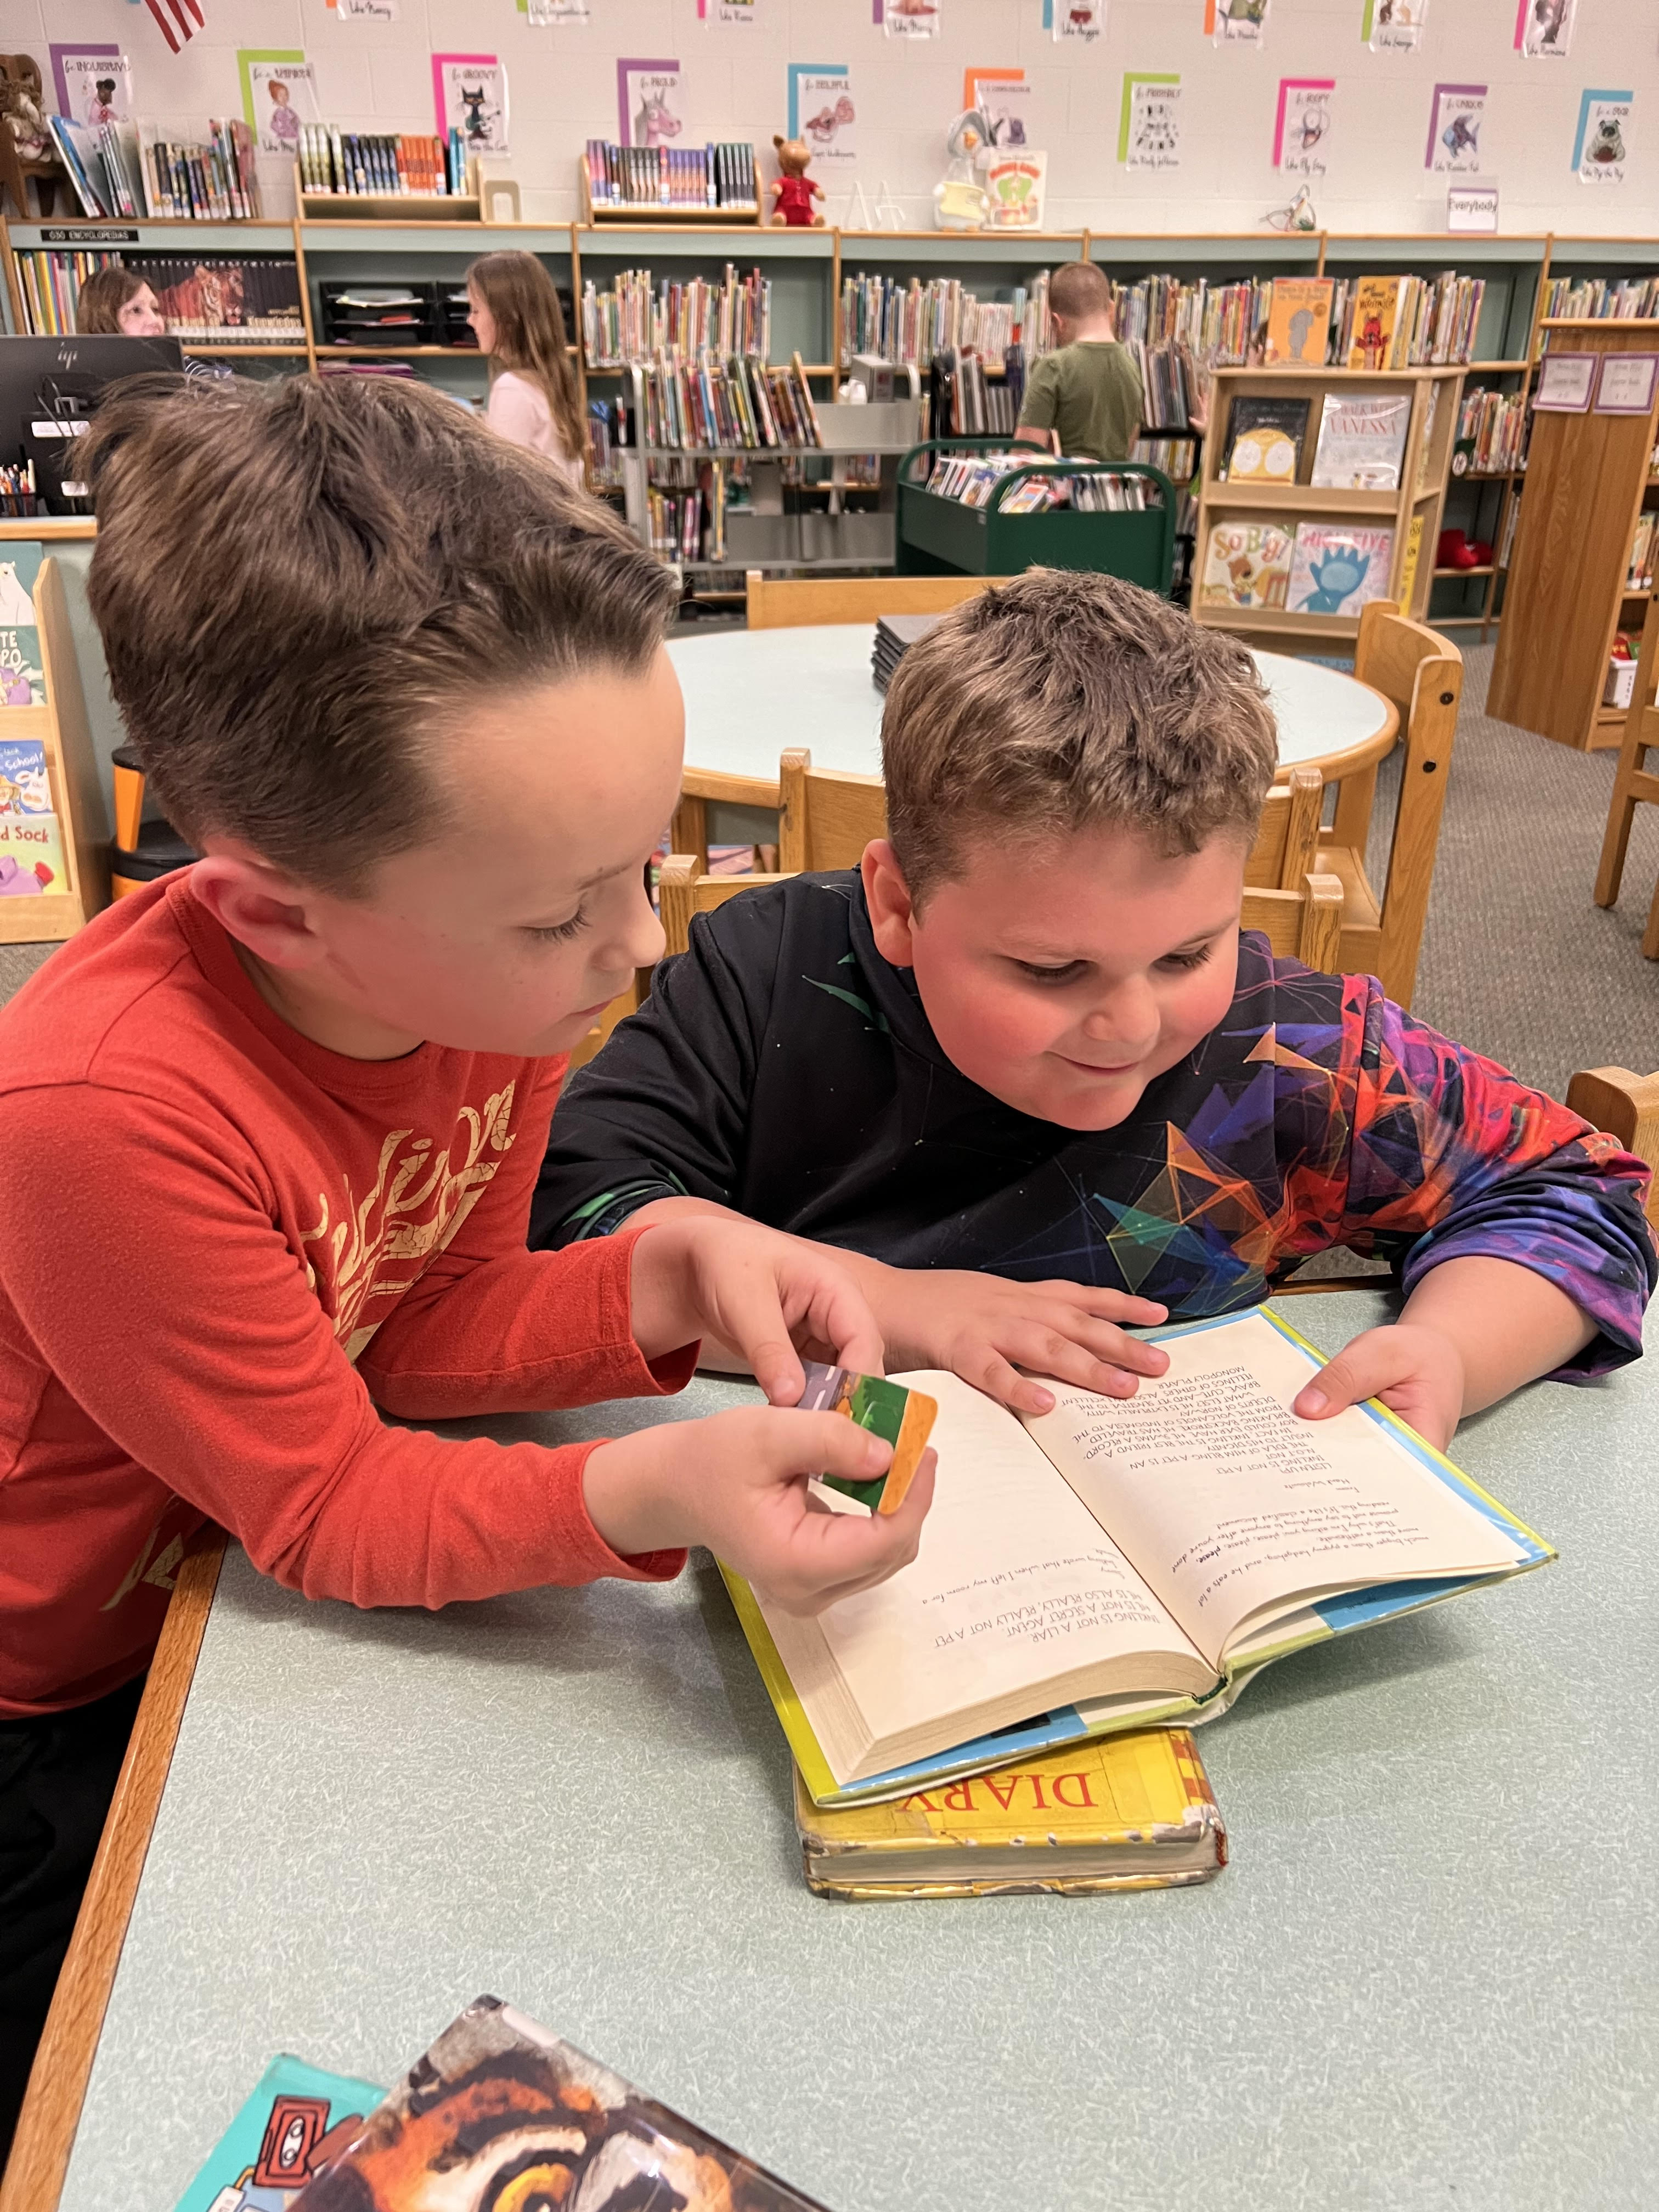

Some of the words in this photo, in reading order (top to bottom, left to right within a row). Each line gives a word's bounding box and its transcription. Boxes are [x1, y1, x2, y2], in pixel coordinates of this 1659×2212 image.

[1448, 198, 1498, 215] Everybody
[15, 825, 48, 843] Sock
[1194, 1367, 1244, 1381] MONOPOLY
[1211, 1373, 1253, 1387] FEELINGS
[1134, 1392, 1156, 1400] ALSO
[1223, 1392, 1255, 1402] WHAT
[1196, 1398, 1221, 1407] ELSE?
[1237, 1396, 1276, 1408] DESERTS
[1118, 1407, 1166, 1415] EXTREMELY
[1255, 1404, 1282, 1414] FROM
[1176, 1412, 1235, 1424] VOLCANOES
[1240, 1412, 1290, 1424] BREAKING
[1108, 1420, 1159, 1430] INDONESIA
[1244, 1422, 1276, 1431] COULD
[1071, 1429, 1090, 1444] THE
[1090, 1429, 1136, 1443] TRAVELED
[1208, 1432, 1250, 1443] INKLING
[1280, 1432, 1314, 1441] INSULT
[1117, 1443, 1151, 1453] FRIEND
[1262, 1443, 1286, 1452] IDEA
[1287, 1442, 1308, 1450] THE
[1104, 1449, 1113, 1458] A
[1192, 1452, 1224, 1460] BEING
[1130, 1460, 1144, 1469] AN
[1281, 1455, 1324, 1465] INKLING
[1300, 1463, 1332, 1471] LISTEN
[1262, 1511, 1296, 1521] classified
[1284, 1517, 1322, 1526] anything
[1348, 1522, 1367, 1530] why
[1217, 1531, 1236, 1539] after
[1189, 1536, 1214, 1554] you're
[1196, 1546, 1221, 1563] please,
[1265, 1550, 1311, 1561] hedgehog,
[1043, 1561, 1059, 1570] that
[1172, 1553, 1187, 1573] done
[1245, 1560, 1261, 1570] and
[1014, 1565, 1039, 1575] when
[991, 1574, 1006, 1585] left
[1008, 1571, 1013, 1580] I
[1213, 1573, 1227, 1587] eats
[947, 1585, 969, 1595] room
[1085, 1589, 1112, 1599] ALSO
[1116, 1590, 1127, 1598] IS
[932, 1594, 944, 1602] for
[1198, 1594, 1207, 1607] lot
[1086, 1602, 1095, 1613] A
[1101, 1601, 1122, 1610] NOT
[1124, 1601, 1136, 1610] IS
[996, 1605, 1036, 1625] REALLY
[1049, 1607, 1085, 1622] SECRET
[1101, 1613, 1113, 1623] IS
[1114, 1612, 1160, 1623] INKLING
[970, 1620, 992, 1635] NOT
[1002, 1615, 1042, 1637] AGENT.
[1061, 1622, 1070, 1632] A
[1076, 1617, 1098, 1629] NOT
[955, 1627, 963, 1639] A
